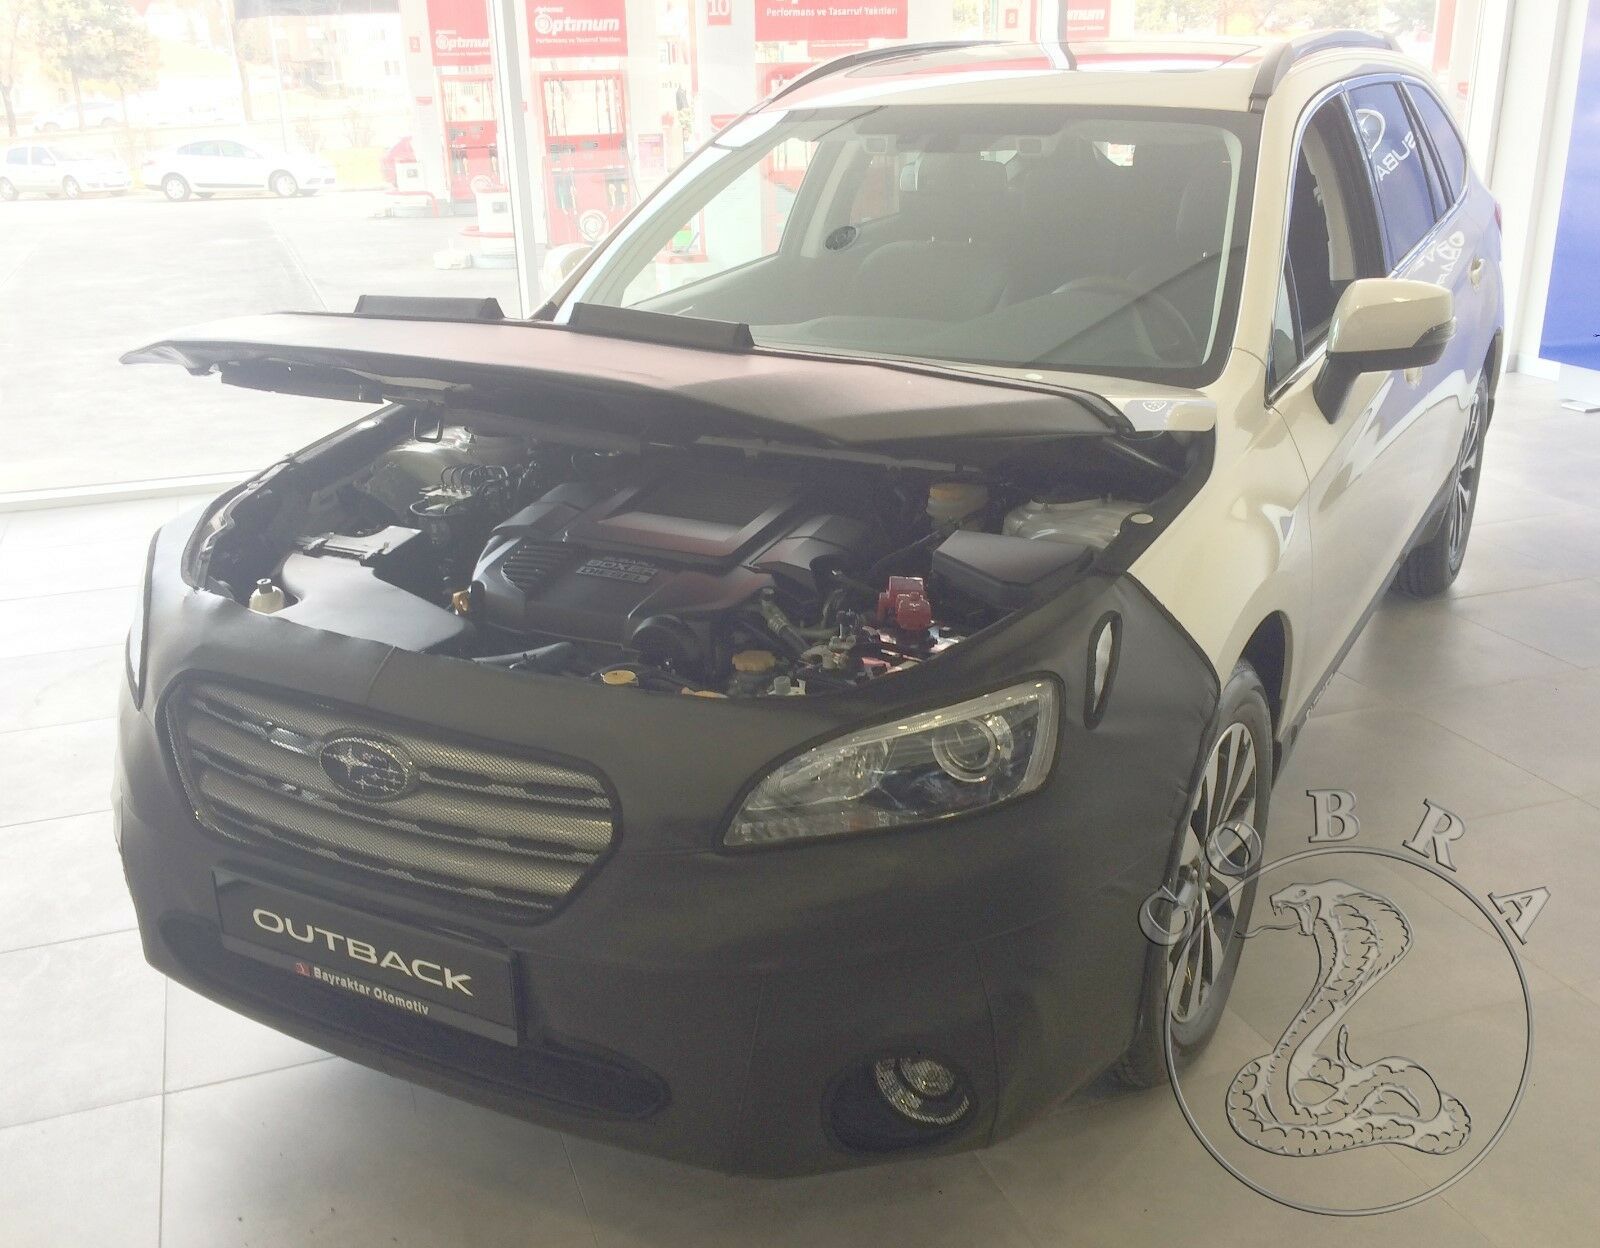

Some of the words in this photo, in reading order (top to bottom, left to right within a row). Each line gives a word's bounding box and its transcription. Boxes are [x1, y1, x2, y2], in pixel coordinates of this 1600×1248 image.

[708, 0, 730, 16] 10
[766, 7, 815, 17] Performans
[817, 8, 828, 16] ve
[534, 13, 620, 36] Optimum
[252, 908, 474, 997] OUTBACK
[313, 966, 371, 996] Bayraktar
[373, 986, 430, 1017] Otomotiv
